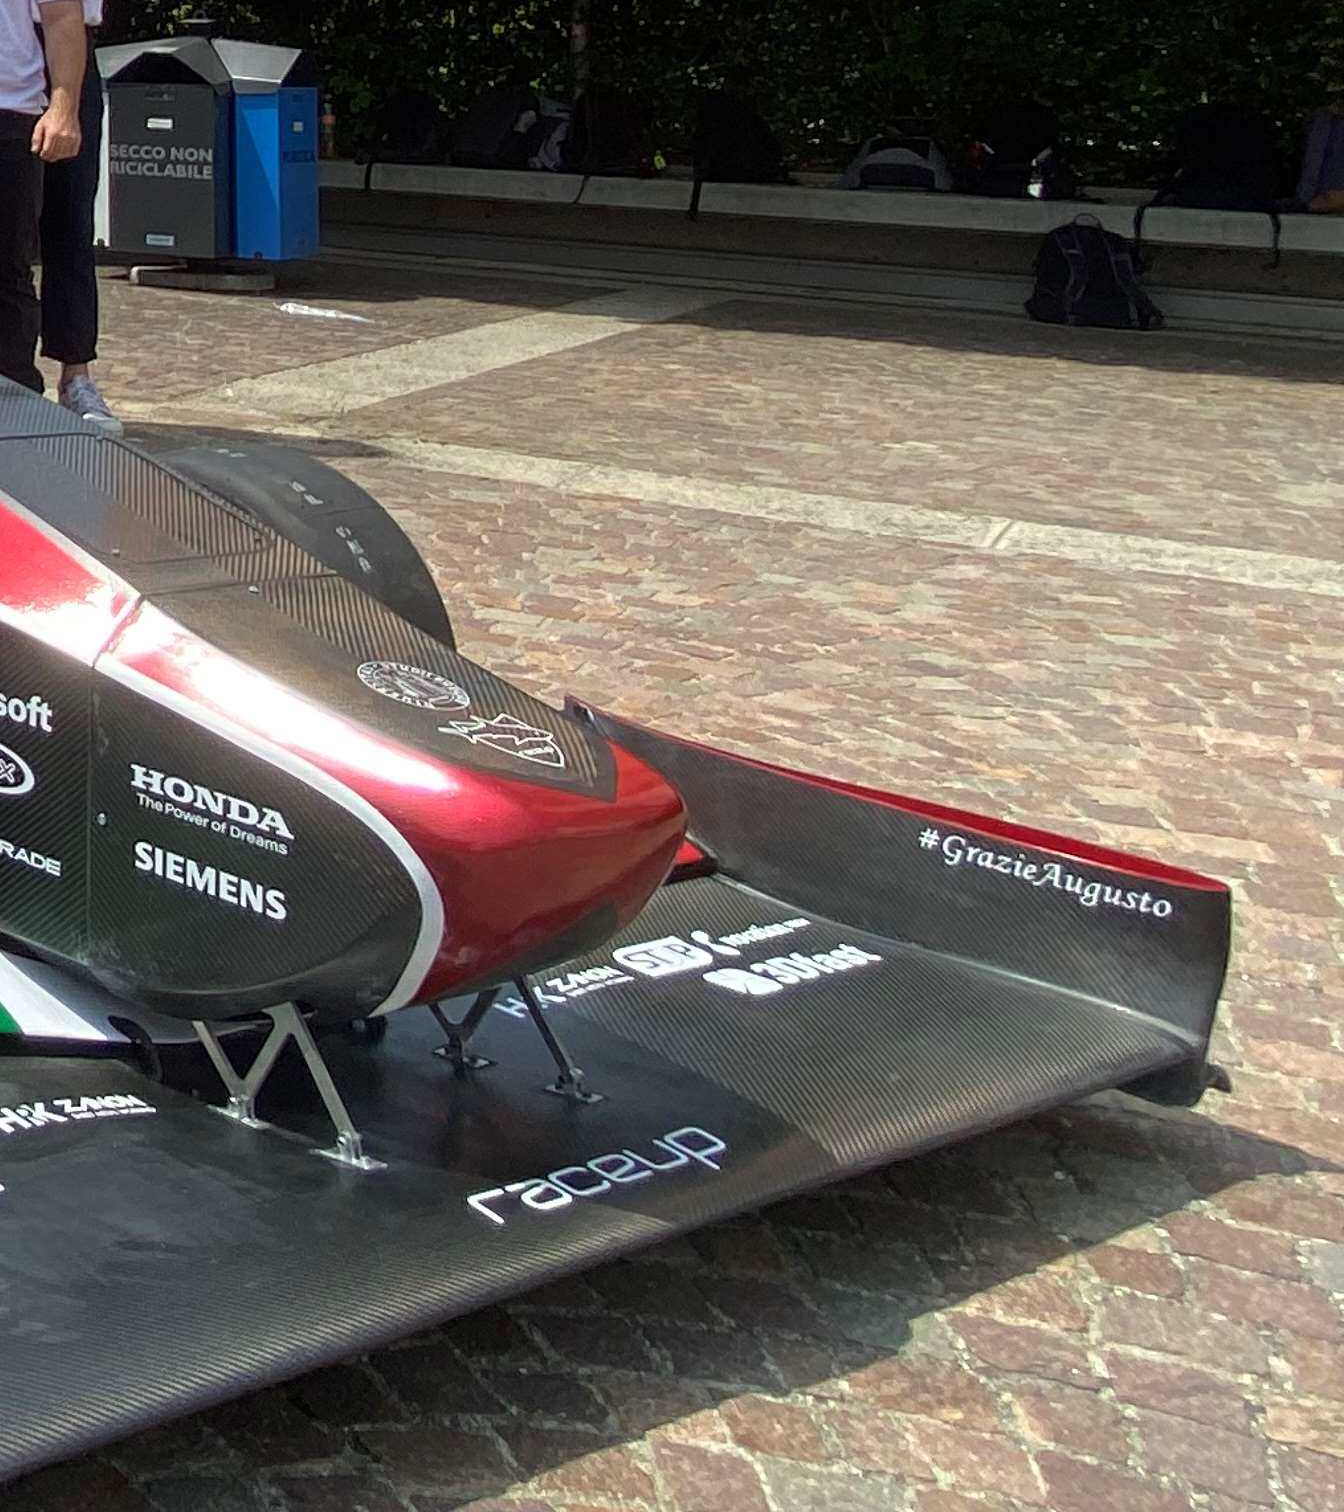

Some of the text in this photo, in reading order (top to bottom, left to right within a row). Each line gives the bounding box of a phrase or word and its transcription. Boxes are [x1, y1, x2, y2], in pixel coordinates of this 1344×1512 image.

[169, 145, 213, 163] NON
[130, 763, 296, 840] HONDA
[136, 791, 289, 856] The Power of Dreams
[134, 841, 288, 921] SIEMENS
[917, 826, 1174, 918] #GrazieAugusto
[466, 1125, 728, 1226] raceup
